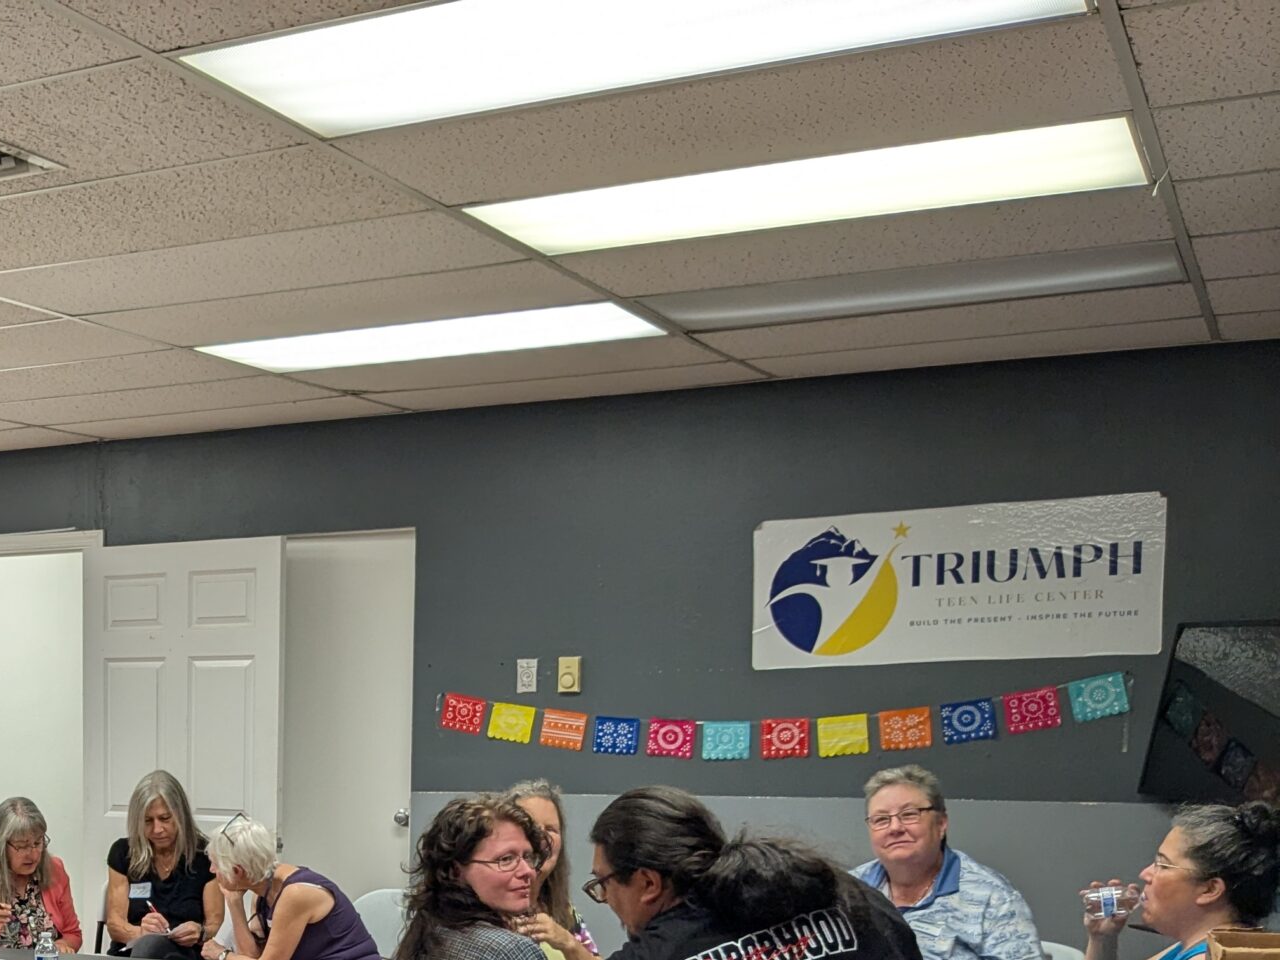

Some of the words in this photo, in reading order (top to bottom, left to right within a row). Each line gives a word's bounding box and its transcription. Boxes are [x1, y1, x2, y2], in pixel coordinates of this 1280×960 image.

[901, 541, 1143, 587] TRIUMPH
[935, 595, 978, 608] TEEN
[987, 593, 1025, 605] LIFE
[1034, 589, 1104, 604] CENTER
[909, 618, 939, 627] BUILD
[943, 617, 963, 626] THE
[967, 615, 1013, 624] PRESENT
[1026, 613, 1068, 622] INSPIRE
[1073, 611, 1093, 620] THE
[1098, 609, 1140, 618] FUTURE
